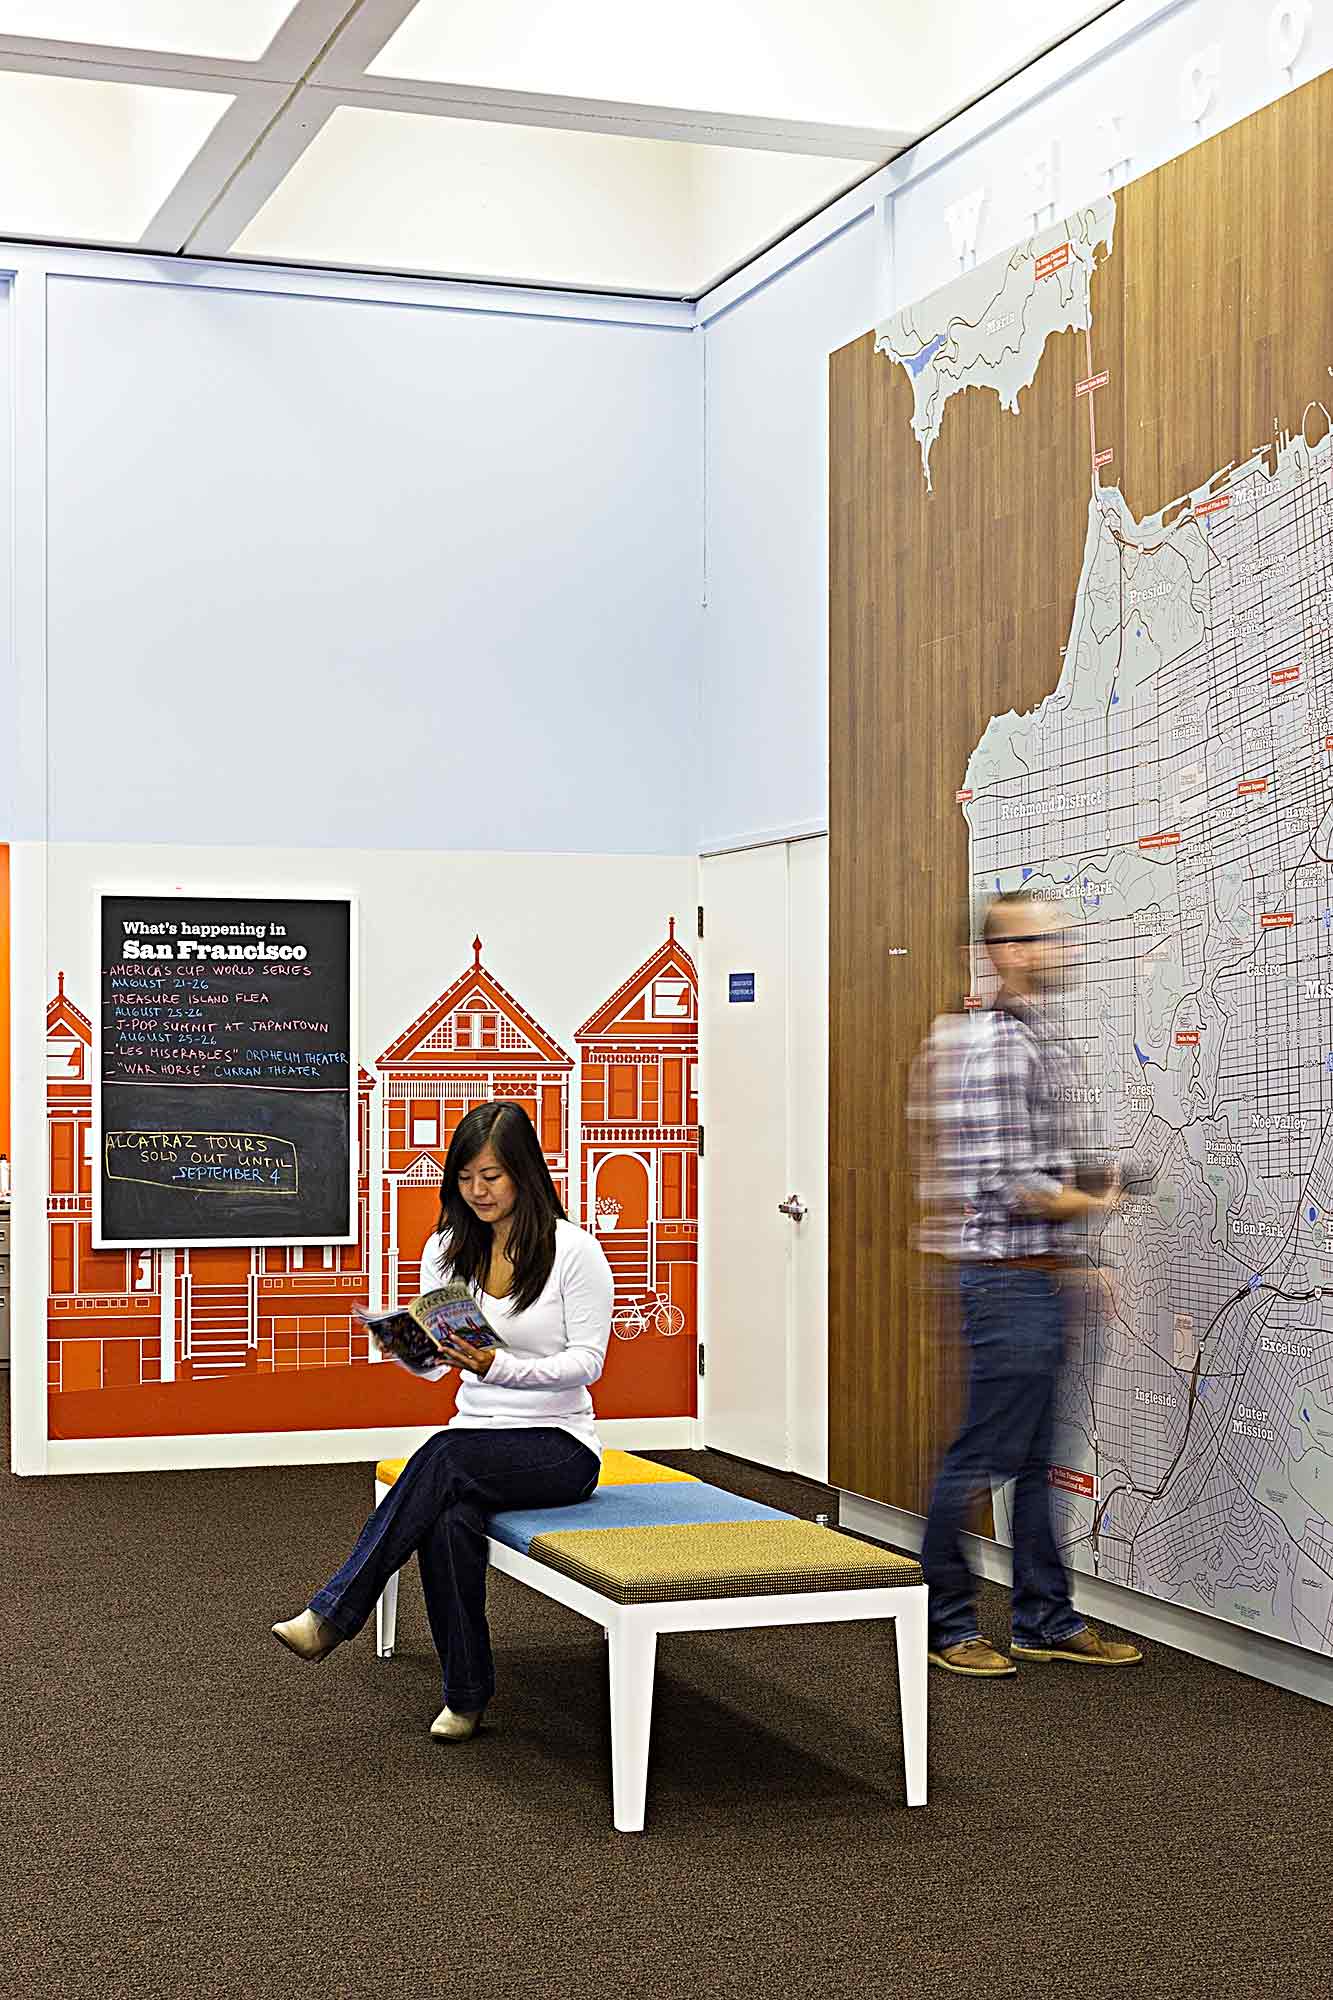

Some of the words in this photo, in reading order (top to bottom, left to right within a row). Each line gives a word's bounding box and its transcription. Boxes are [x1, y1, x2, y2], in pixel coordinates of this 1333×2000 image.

[1233, 480, 1280, 506] Marina
[1260, 553, 1287, 567] Hollow
[1240, 574, 1262, 585] Union
[1263, 566, 1288, 580] Street
[1129, 581, 1172, 603] Presidio
[1230, 609, 1259, 623] Pacific
[1228, 622, 1260, 637] Heights
[1226, 684, 1259, 697] Fillmore
[1262, 692, 1299, 706] Japantown
[1175, 711, 1200, 724] Laurel
[1305, 707, 1330, 719] Civic
[1172, 726, 1201, 739] Heights
[1245, 726, 1278, 738] Western
[1245, 738, 1280, 752] Addition
[1001, 798, 1055, 820] Richmond
[1057, 790, 1103, 810] District
[1286, 807, 1314, 817] Hayes
[1215, 808, 1237, 819] NOPA
[1285, 820, 1313, 832] Valley
[1187, 841, 1213, 852] Haight
[1185, 855, 1217, 867] Ashbury
[1299, 868, 1321, 880] Upper
[1296, 878, 1325, 889] Market
[1030, 885, 1062, 901] Golden
[1062, 884, 1085, 899] Gate
[1087, 881, 1113, 895] Park
[1185, 897, 1204, 907] Cole
[1133, 911, 1174, 922] Parnassus
[1181, 909, 1205, 920] Valley
[123, 921, 178, 935] What's
[181, 921, 266, 938] happening
[269, 922, 286, 936] in
[1139, 924, 1169, 936] Heights
[122, 940, 174, 960] San
[177, 940, 308, 960] Francisco
[176, 965, 205, 976] CUP
[213, 965, 255, 976] WORLD
[262, 965, 312, 976] SERIES
[1246, 962, 1281, 976] Castro
[112, 979, 166, 989] AUGUST
[175, 979, 209, 990] 21-26
[112, 993, 180, 1005] TREASURE
[188, 993, 229, 1005] ISLAND
[235, 993, 269, 1003] FLEA
[115, 1006, 162, 1017] AUGUST
[167, 1008, 203, 1018] 25-26
[116, 1018, 158, 1031] J-POP
[163, 1021, 218, 1033] SUMMIT
[225, 1022, 245, 1032] AT
[249, 1020, 329, 1033] JAPANTOWN
[119, 1032, 173, 1043] AUGUST
[178, 1033, 217, 1045] 25-26
[246, 1049, 300, 1064] ORPHEUM
[304, 1052, 349, 1066] THEATER
[214, 1065, 261, 1077] CURRAN
[268, 1065, 321, 1077] THEATER
[1125, 1082, 1155, 1096] Forest
[1131, 1098, 1149, 1112] Hill
[1251, 1115, 1272, 1128] Noe
[1273, 1115, 1307, 1131] Valley
[106, 1135, 197, 1150] ALCATRAZ
[205, 1136, 268, 1152] TOURS
[1205, 1140, 1242, 1153] Diamond
[140, 1151, 178, 1163] SOLD
[191, 1151, 229, 1164] OUT
[239, 1154, 293, 1168] UNTIL
[1206, 1153, 1240, 1168] Heights
[172, 1166, 265, 1183] SEPTEMBER
[270, 1168, 281, 1185] 4
[1124, 1203, 1152, 1214] Francis
[1121, 1215, 1143, 1226] Wood
[1232, 1220, 1258, 1234] Glen
[1258, 1223, 1285, 1238] Park
[1260, 1337, 1313, 1358] Excelsior
[1135, 1388, 1177, 1408] Ingleside
[1238, 1404, 1268, 1420] Outer
[1232, 1419, 1274, 1441] Mission
